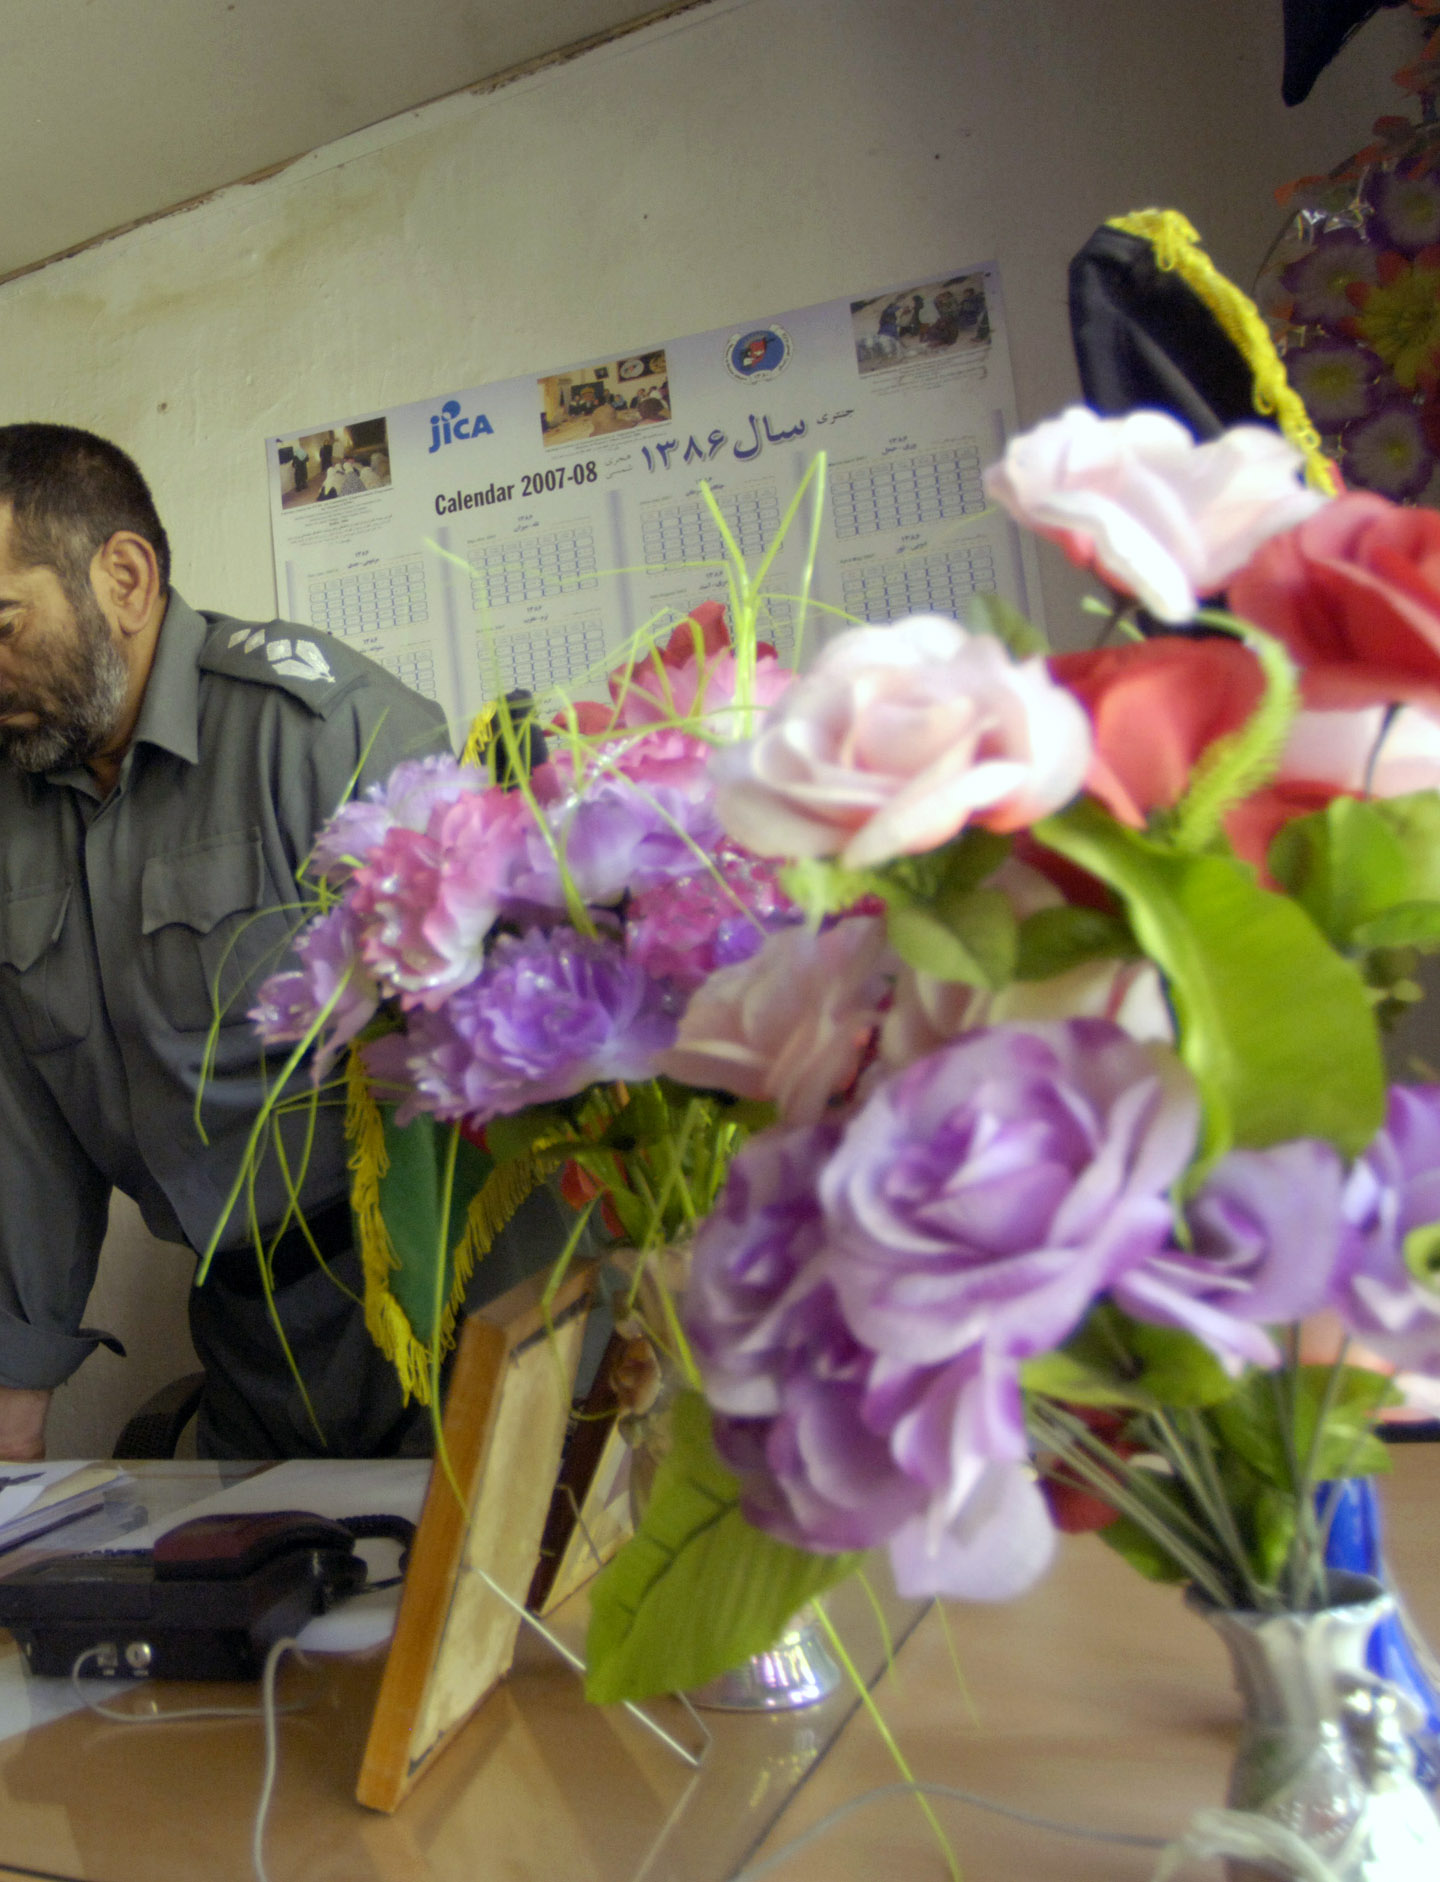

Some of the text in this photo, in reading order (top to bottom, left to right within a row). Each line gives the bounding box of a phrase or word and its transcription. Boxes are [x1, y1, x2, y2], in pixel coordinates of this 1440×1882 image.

[733, 414, 808, 460] سال
[434, 483, 516, 516] Calendar
[520, 460, 599, 497] 2007-08
